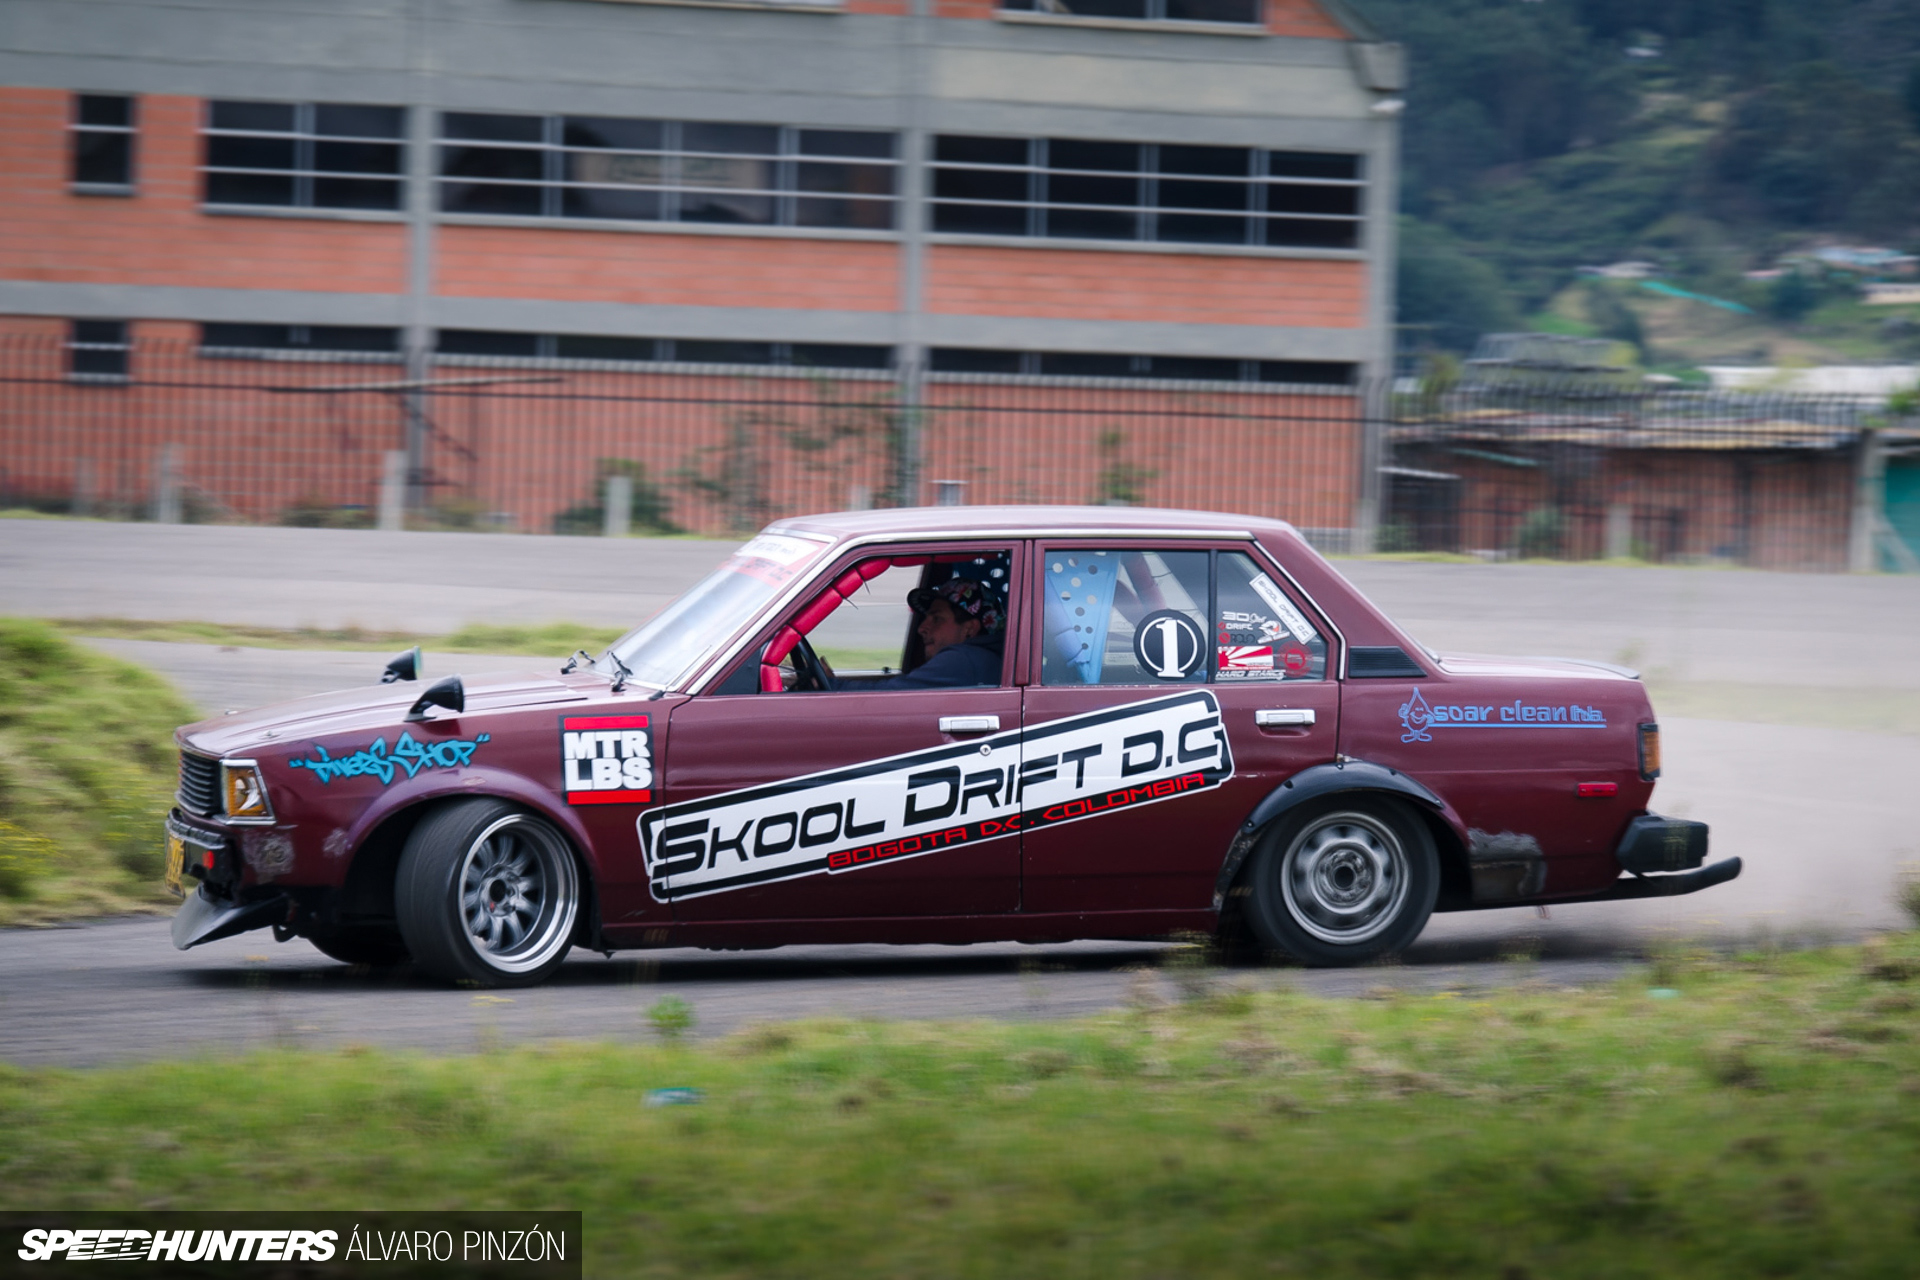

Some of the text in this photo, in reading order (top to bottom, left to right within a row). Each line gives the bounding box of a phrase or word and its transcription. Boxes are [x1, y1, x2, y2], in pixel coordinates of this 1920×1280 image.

[1155, 619, 1185, 678] 1
[1433, 705, 1493, 722] soar
[1500, 700, 1567, 722] clean
[564, 730, 650, 760] MTR
[564, 757, 652, 792] LBS
[652, 797, 886, 877] SKOOL
[903, 743, 1102, 827] DRIFT
[828, 827, 967, 868] BOGOTA
[1042, 773, 1205, 821] COLOMBIA
